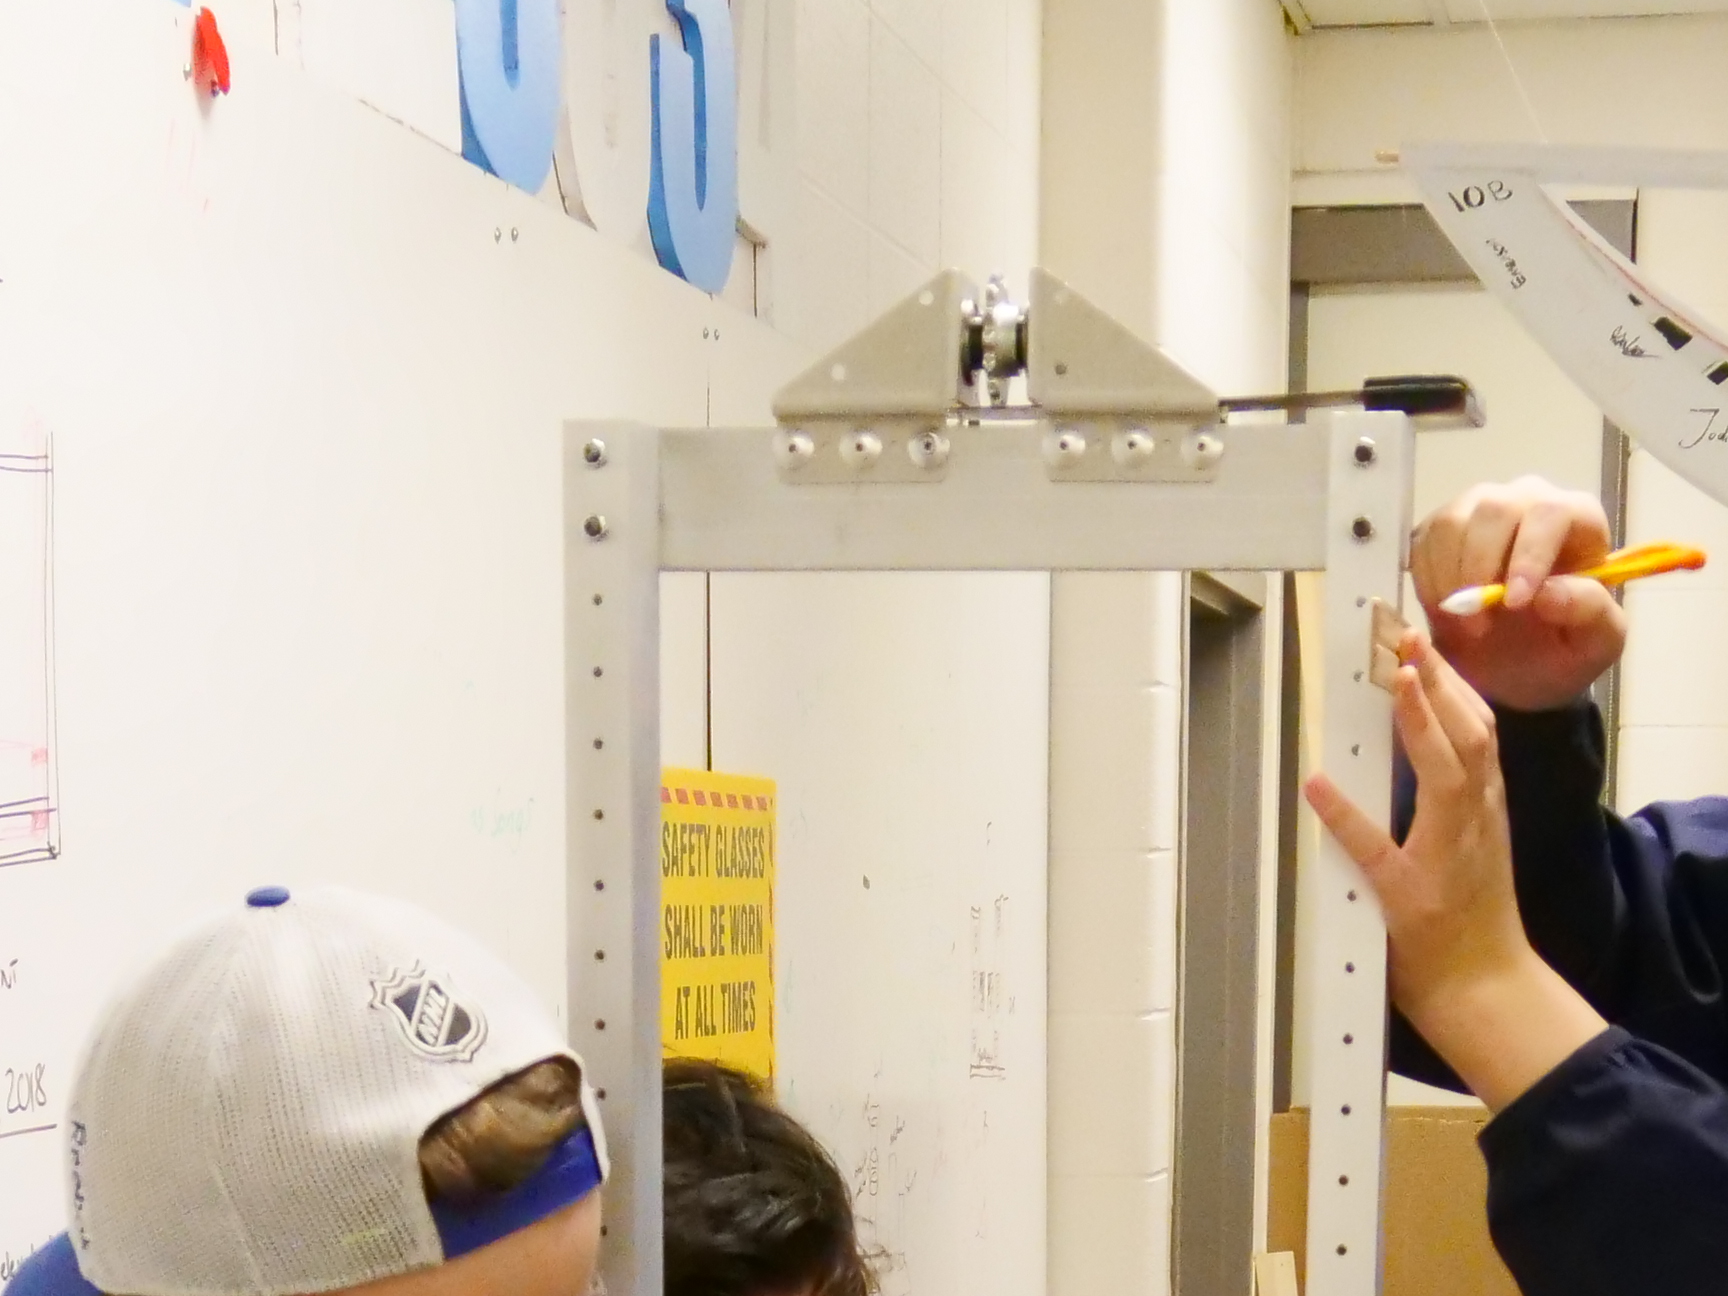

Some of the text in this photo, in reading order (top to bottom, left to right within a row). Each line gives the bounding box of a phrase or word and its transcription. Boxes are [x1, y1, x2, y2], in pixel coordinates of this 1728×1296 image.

[661, 820, 765, 879] SAFETY GLASSES
[664, 903, 763, 961] SHALL BE WORN
[674, 980, 756, 1040] AT ALL TIMES
[5, 1062, 48, 1114] 2018
